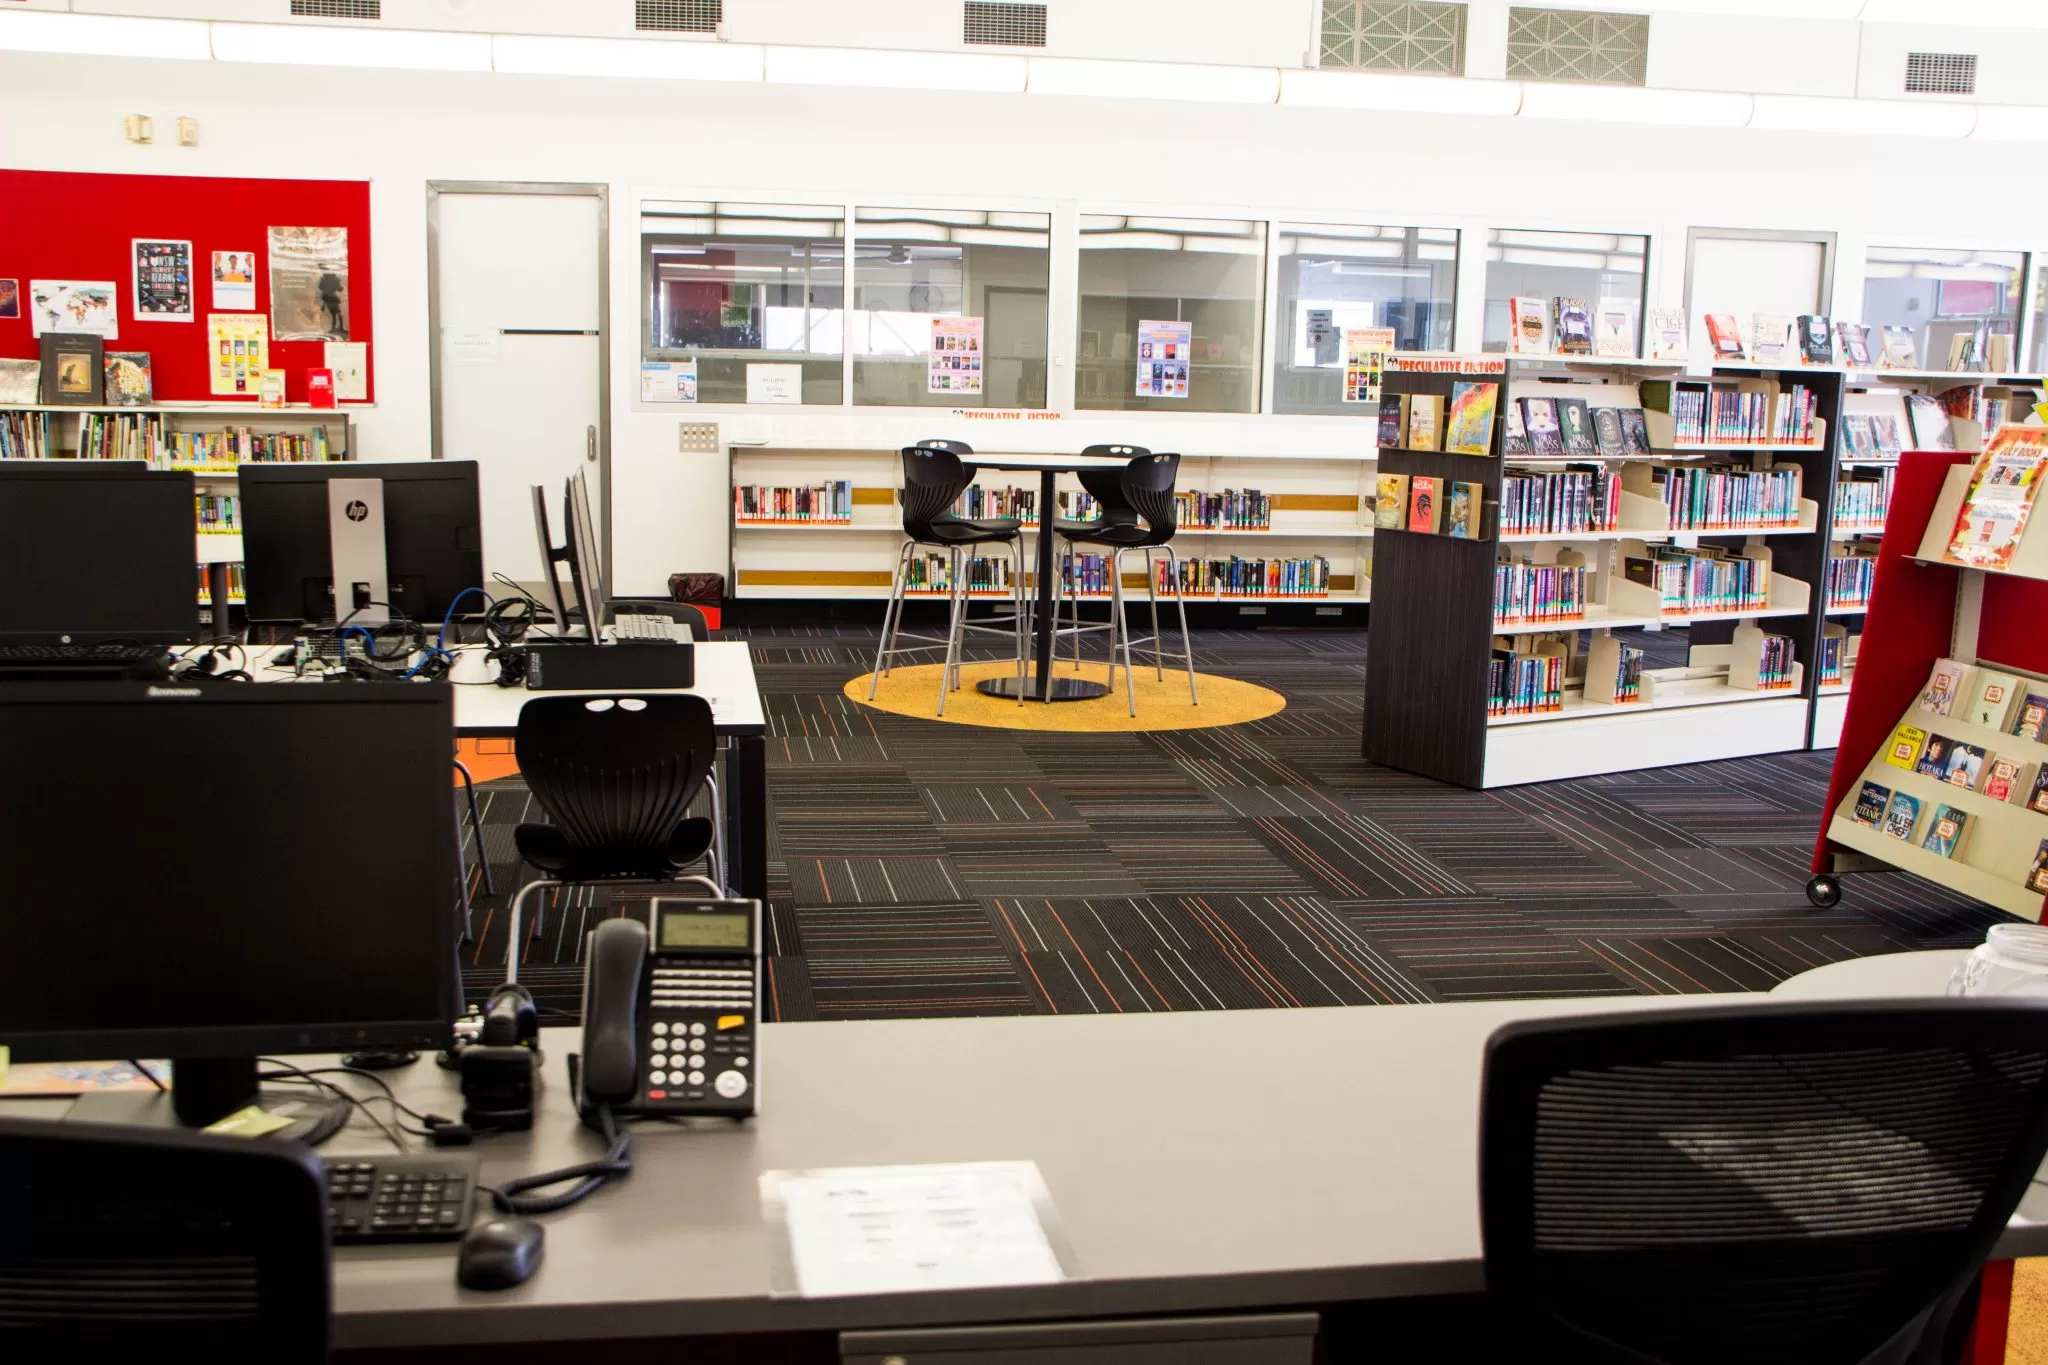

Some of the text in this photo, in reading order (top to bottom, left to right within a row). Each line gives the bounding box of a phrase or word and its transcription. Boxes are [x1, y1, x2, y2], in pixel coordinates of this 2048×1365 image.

[1399, 360, 1504, 373] SPECULATIVE FICTION
[964, 412, 1061, 420] SPECULATIVE FICTION
[1534, 440, 1559, 450] MOSS
[1568, 440, 1593, 449] MOSS
[1918, 762, 1944, 777] HOTAKA
[1855, 805, 1882, 820] TITANIC
[1889, 811, 1914, 828] KILLER
[1886, 823, 1908, 837] CHEF
